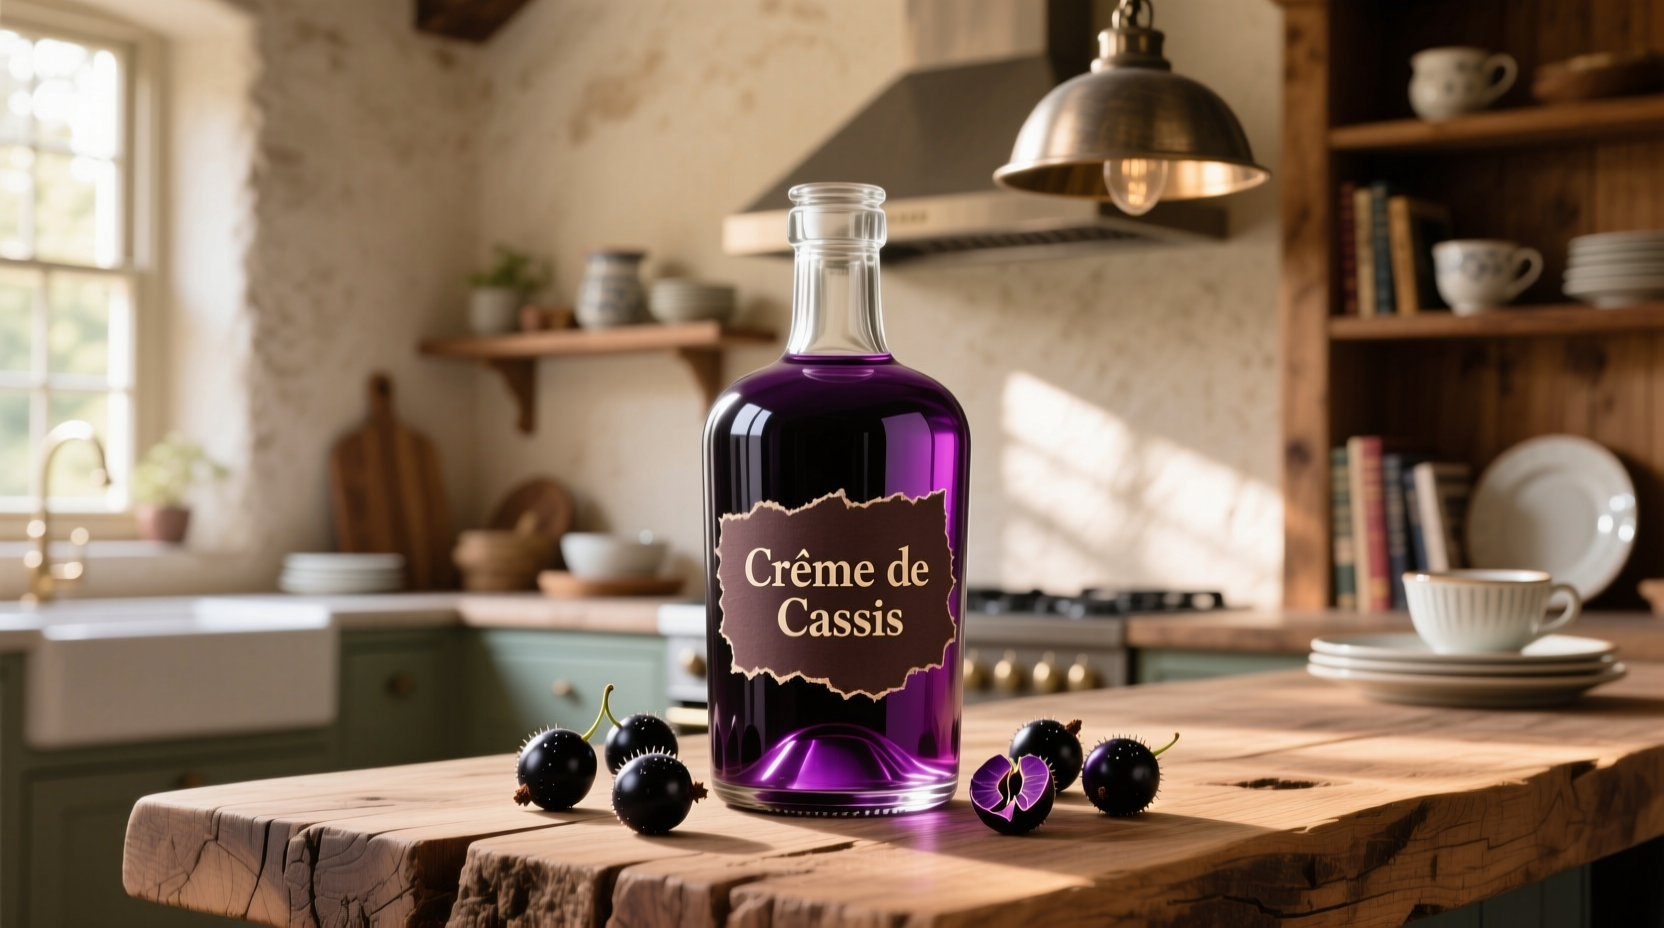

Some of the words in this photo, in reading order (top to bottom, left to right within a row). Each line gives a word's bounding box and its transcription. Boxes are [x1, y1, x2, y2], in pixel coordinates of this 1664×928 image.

[744, 547, 875, 588] Crême
[887, 545, 929, 588] de
[777, 597, 904, 637] Cassis
